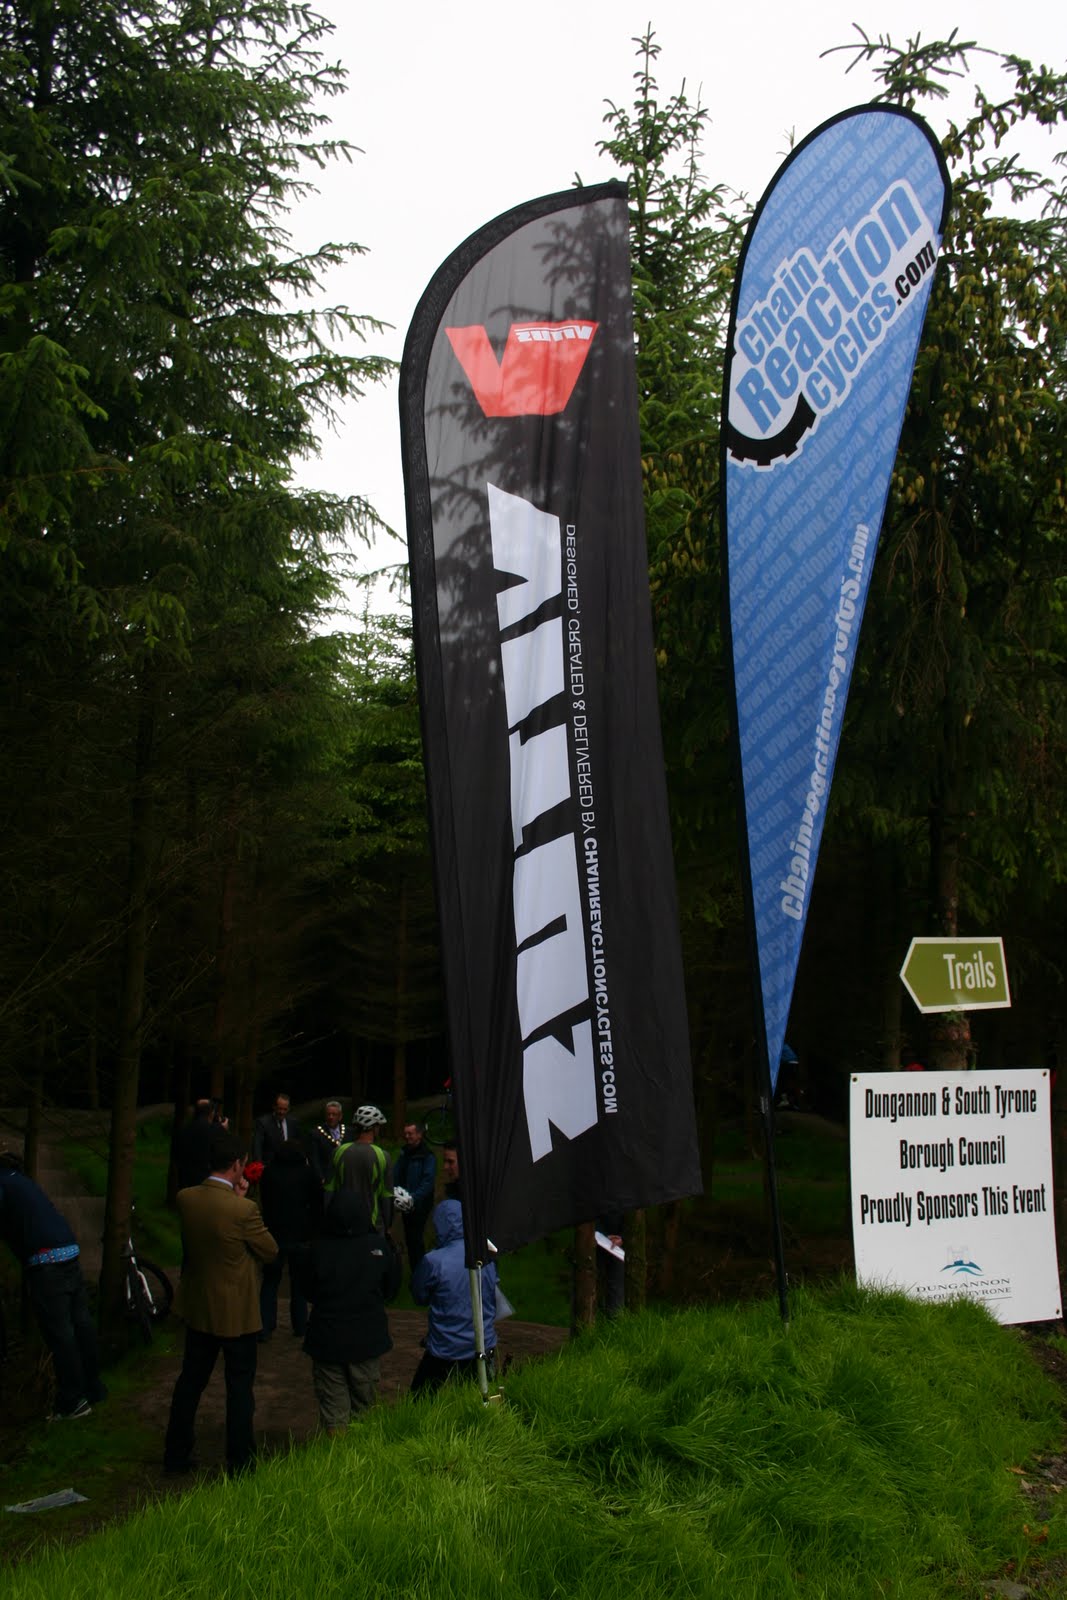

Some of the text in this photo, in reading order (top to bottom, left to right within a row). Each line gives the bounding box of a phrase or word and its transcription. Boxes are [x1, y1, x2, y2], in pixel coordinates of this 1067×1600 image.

[735, 186, 923, 434] Reaction
[943, 950, 996, 990] Trails
[865, 1085, 1037, 1122] Dungannon & South Tyrone
[900, 1135, 1006, 1172] Borough Council
[860, 1183, 1047, 1227] Proudly Sponsors This Event
[916, 1278, 1011, 1293] DUNGANNON
